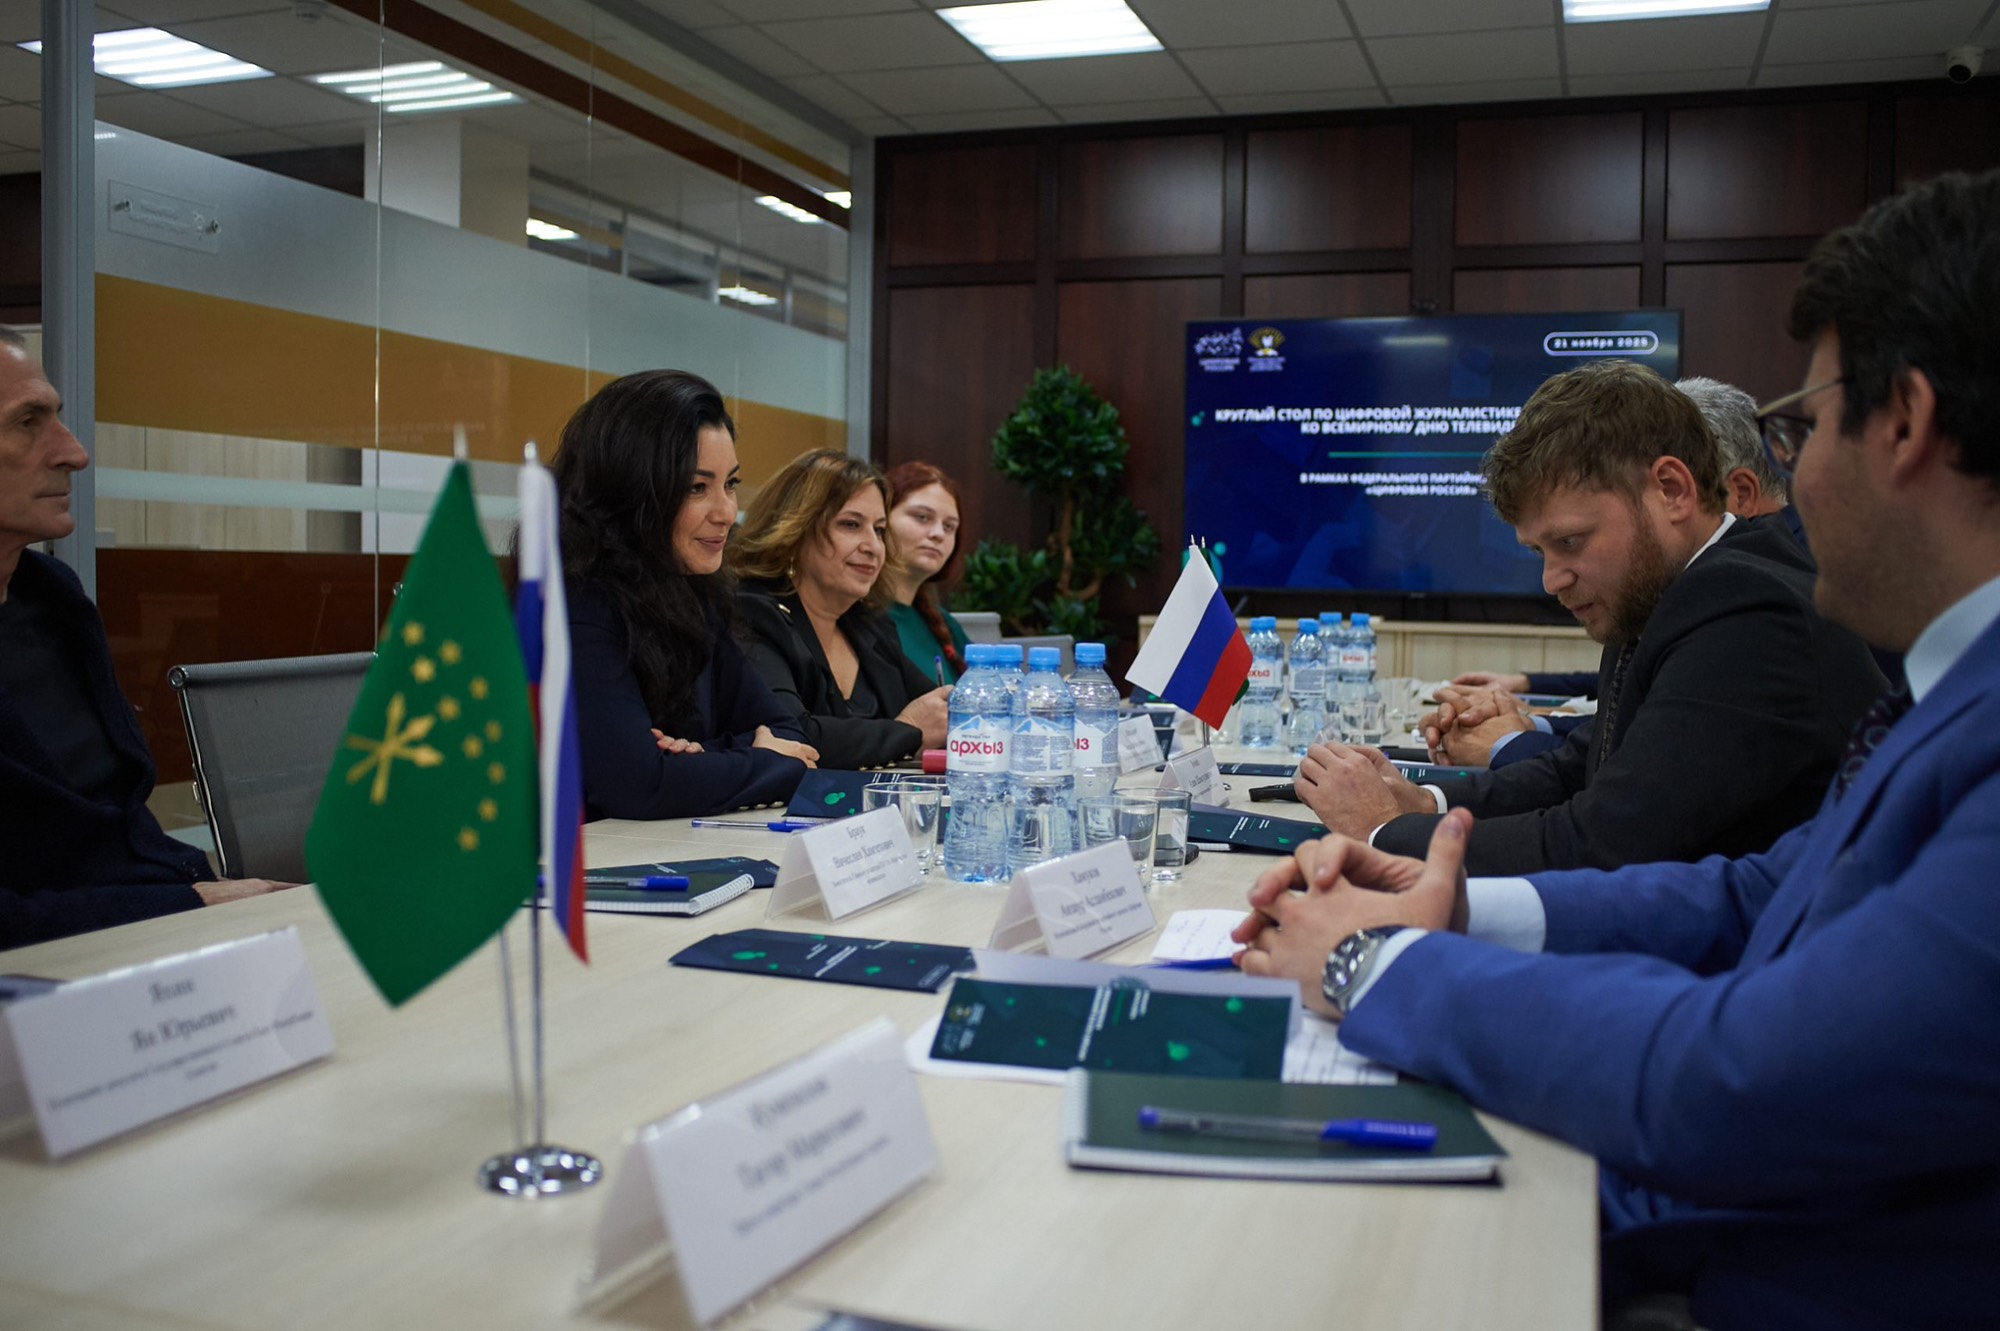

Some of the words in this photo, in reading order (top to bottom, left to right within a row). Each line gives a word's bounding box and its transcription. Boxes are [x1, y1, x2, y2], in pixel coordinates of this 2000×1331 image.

[1571, 337, 1614, 350] ноября
[1215, 405, 1275, 421] КРУГЛЫЙ
[1277, 408, 1311, 421] СТОЛ
[1313, 408, 1333, 421] ПО
[1335, 404, 1411, 422] ЦИФРОВОЙ
[1301, 421, 1320, 434] КО
[1321, 420, 1414, 434] ВСЕМИРНОМУ
[1414, 420, 1449, 436] ДНЮ
[1300, 473, 1307, 484] В
[1309, 473, 1349, 484] РАМКАХ
[1350, 473, 1428, 485] ФЕДЕРАЛЬНОГО
[950, 739, 1004, 757] архыз
